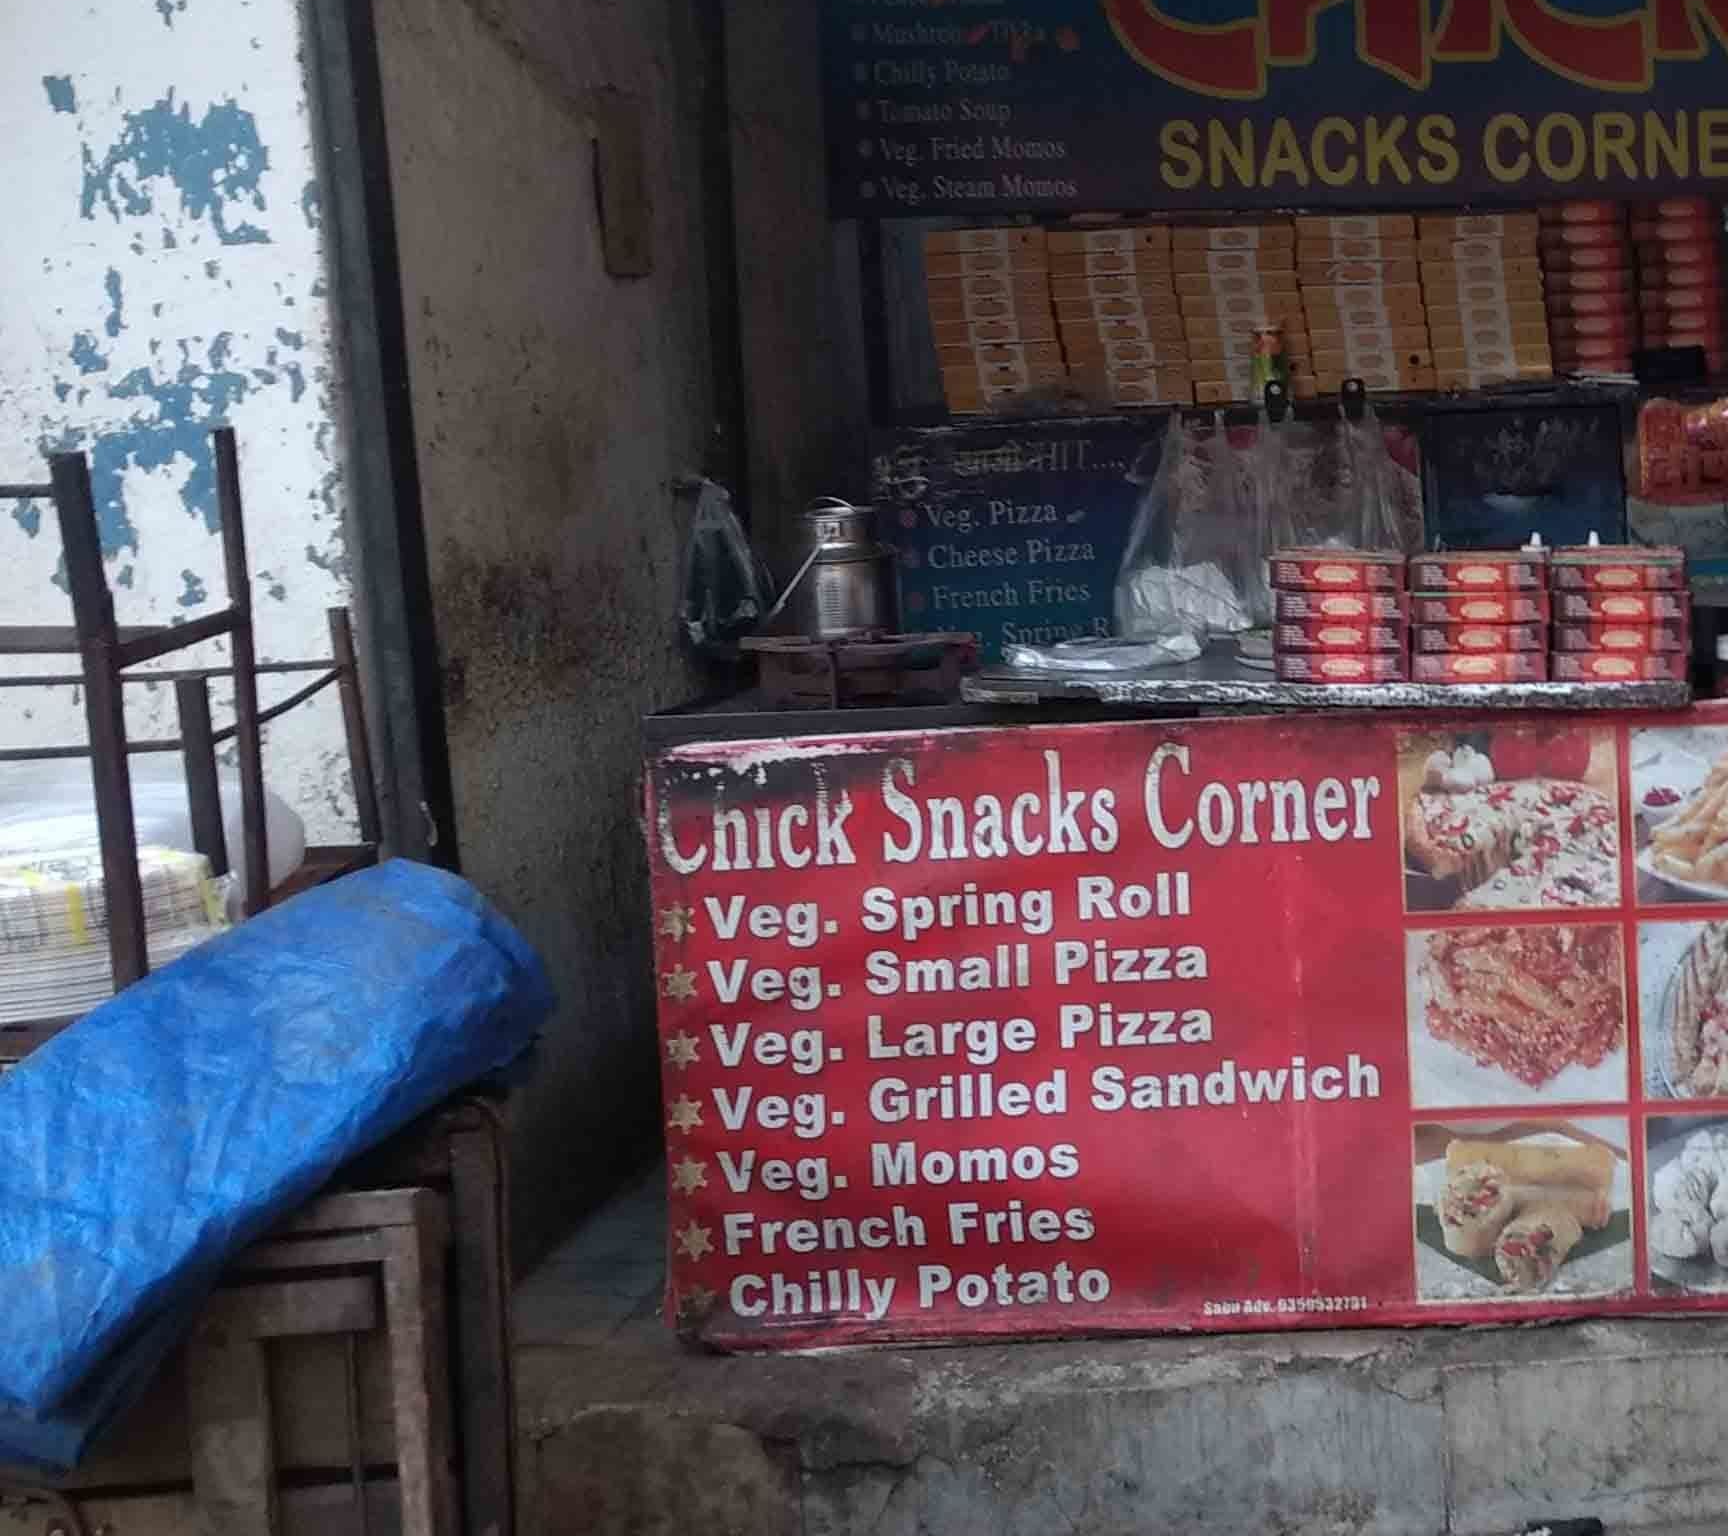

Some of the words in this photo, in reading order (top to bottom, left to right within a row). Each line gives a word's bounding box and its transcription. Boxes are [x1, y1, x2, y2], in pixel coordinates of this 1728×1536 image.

[1159, 114, 1459, 189] SNACKS
[923, 502, 981, 533] Veg.
[989, 499, 1057, 525] Pizza
[928, 544, 1019, 568] Cheese
[1024, 538, 1096, 562] Pizza
[932, 586, 1018, 609] French
[1025, 580, 1090, 603] Fries
[882, 750, 1119, 863] Snacks
[1144, 742, 1381, 847] Corner
[704, 896, 838, 949] Veg.
[861, 883, 1054, 943] Spring
[1077, 871, 1192, 921] Roll
[706, 960, 842, 1011] Veg.
[865, 944, 1031, 996] Small
[1054, 941, 1209, 985] Pizza
[710, 1023, 843, 1074] Veg.
[867, 1013, 1037, 1060] Large
[1059, 1002, 1213, 1048] Pizza
[712, 1087, 846, 1138] Veg.
[870, 1070, 1067, 1123] Grilled
[1091, 1056, 1381, 1111] Sandwich
[716, 1150, 849, 1200] Veg.
[871, 1141, 1080, 1187] Momos
[722, 1206, 926, 1256] French
[948, 1199, 1096, 1247] Fries
[729, 1271, 896, 1321] Chilly
[919, 1261, 1111, 1310] Potato
